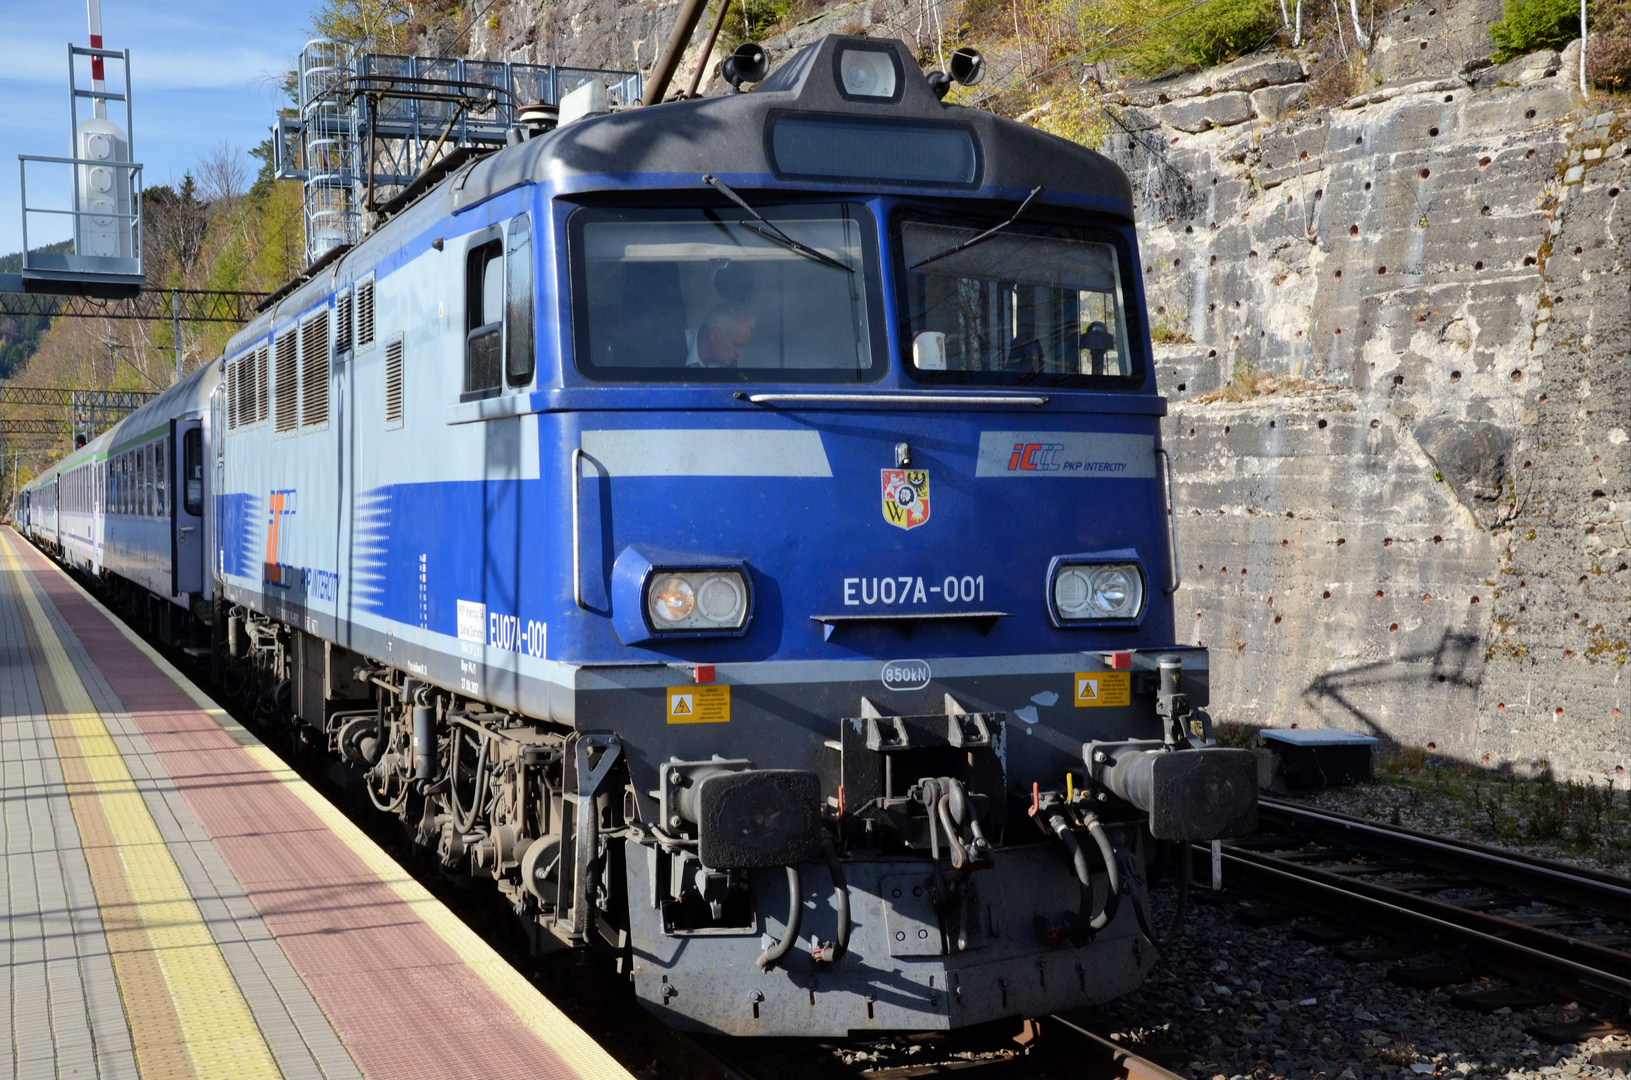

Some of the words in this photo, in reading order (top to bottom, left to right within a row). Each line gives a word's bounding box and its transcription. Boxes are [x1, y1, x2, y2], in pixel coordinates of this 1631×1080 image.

[1063, 461, 1082, 471] PKP
[1084, 462, 1127, 472] INTERCITY
[844, 576, 984, 606] EU07A-001
[490, 612, 547, 660] EU07A-001
[885, 667, 927, 683] 850kN
